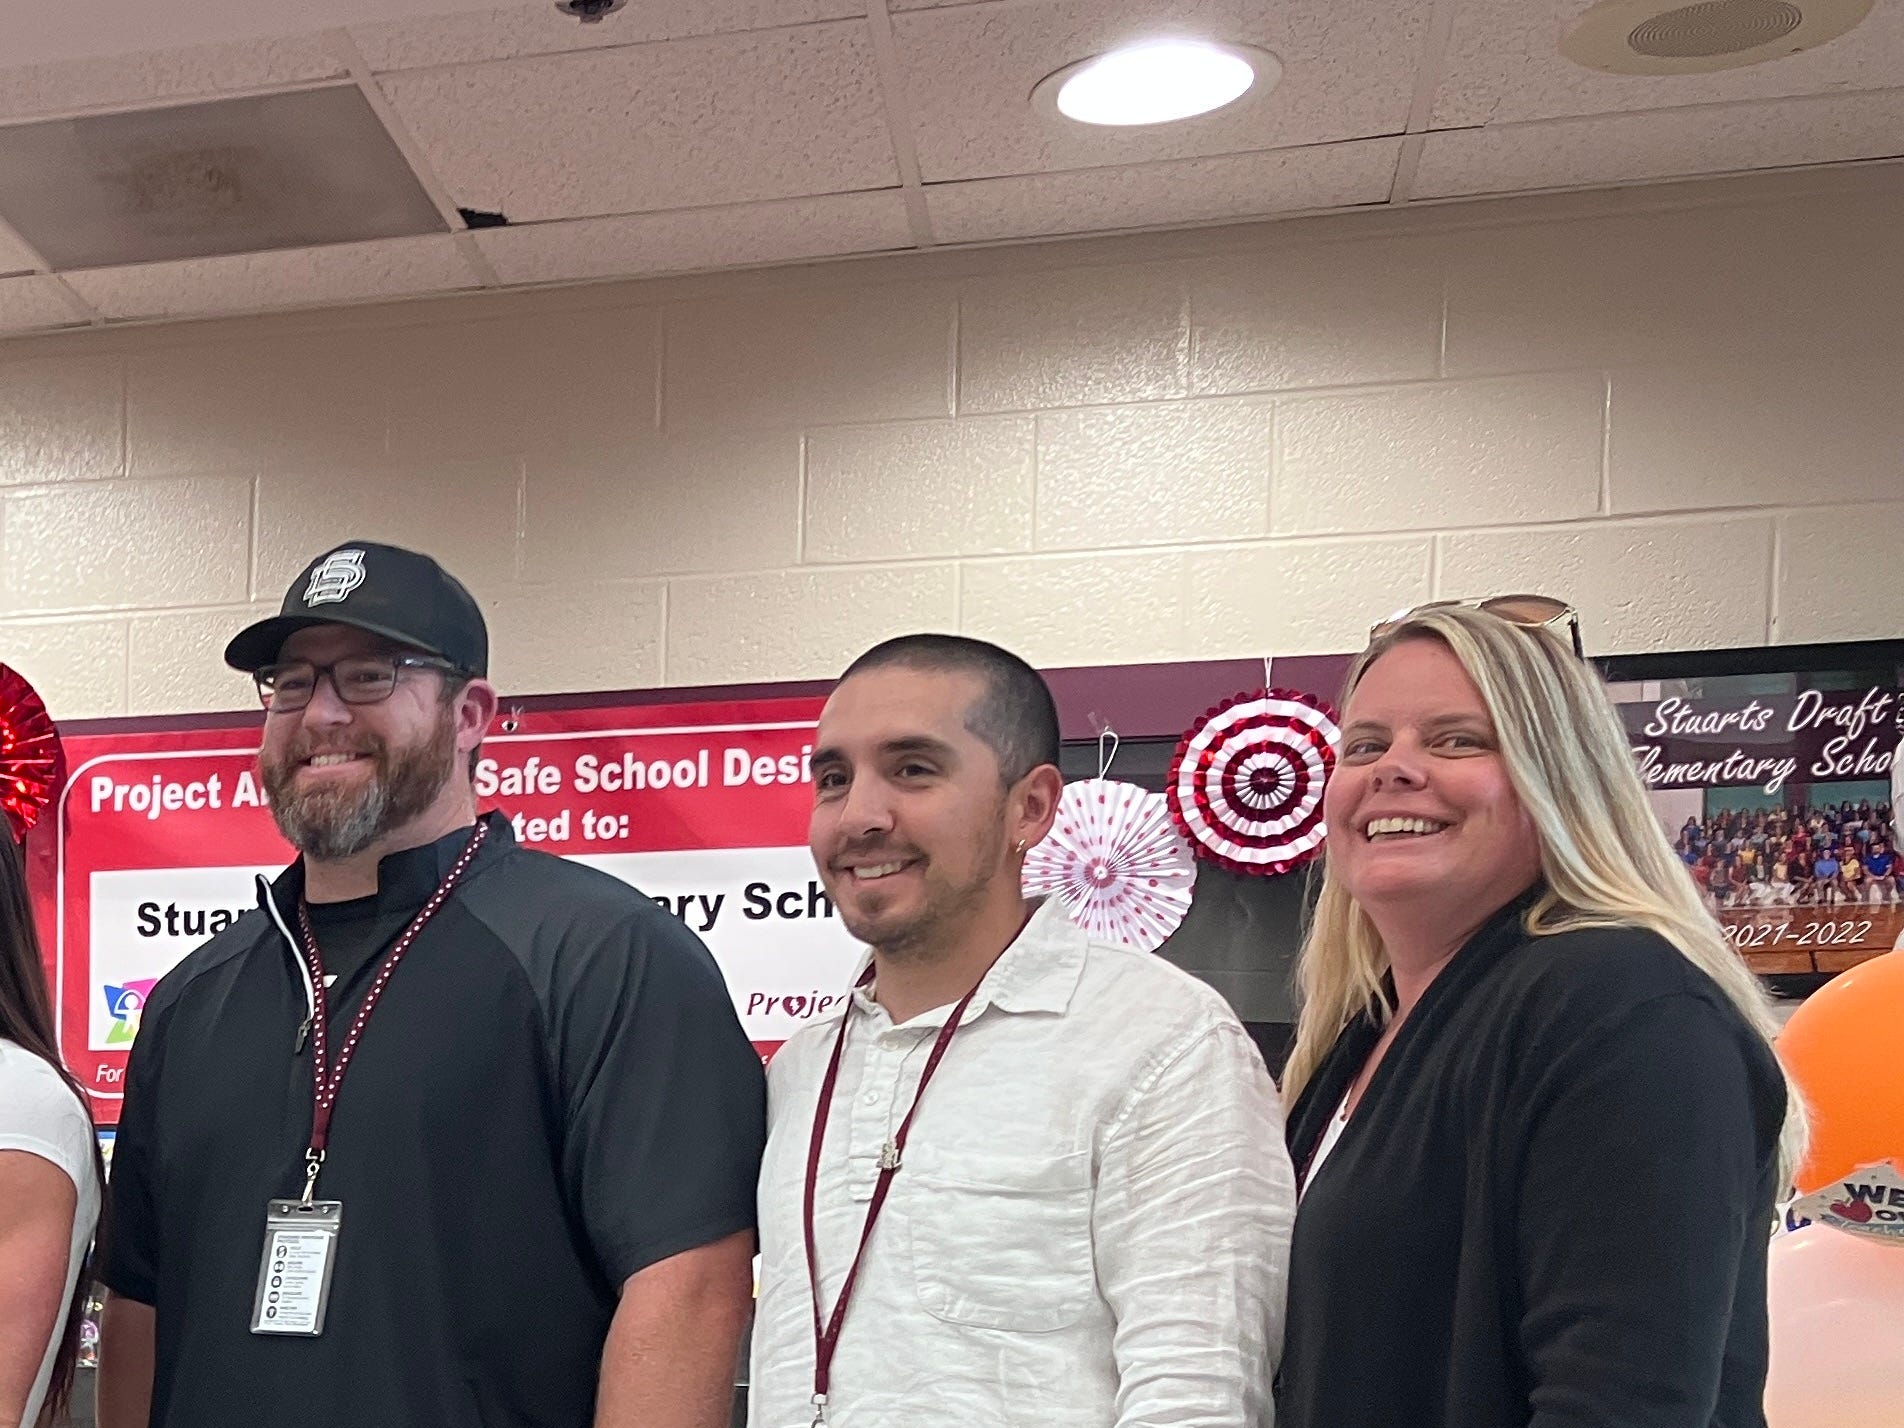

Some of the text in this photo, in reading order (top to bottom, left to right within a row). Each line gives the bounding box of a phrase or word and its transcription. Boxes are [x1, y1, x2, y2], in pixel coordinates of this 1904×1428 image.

[1644, 685, 1894, 740] Stuarts Draft
[90, 772, 222, 821] Project
[231, 770, 271, 809] A
[474, 756, 562, 798] Safe
[573, 748, 709, 793] School
[1631, 744, 1797, 796] lementary
[581, 808, 630, 841] to:
[95, 1063, 124, 1083] For
